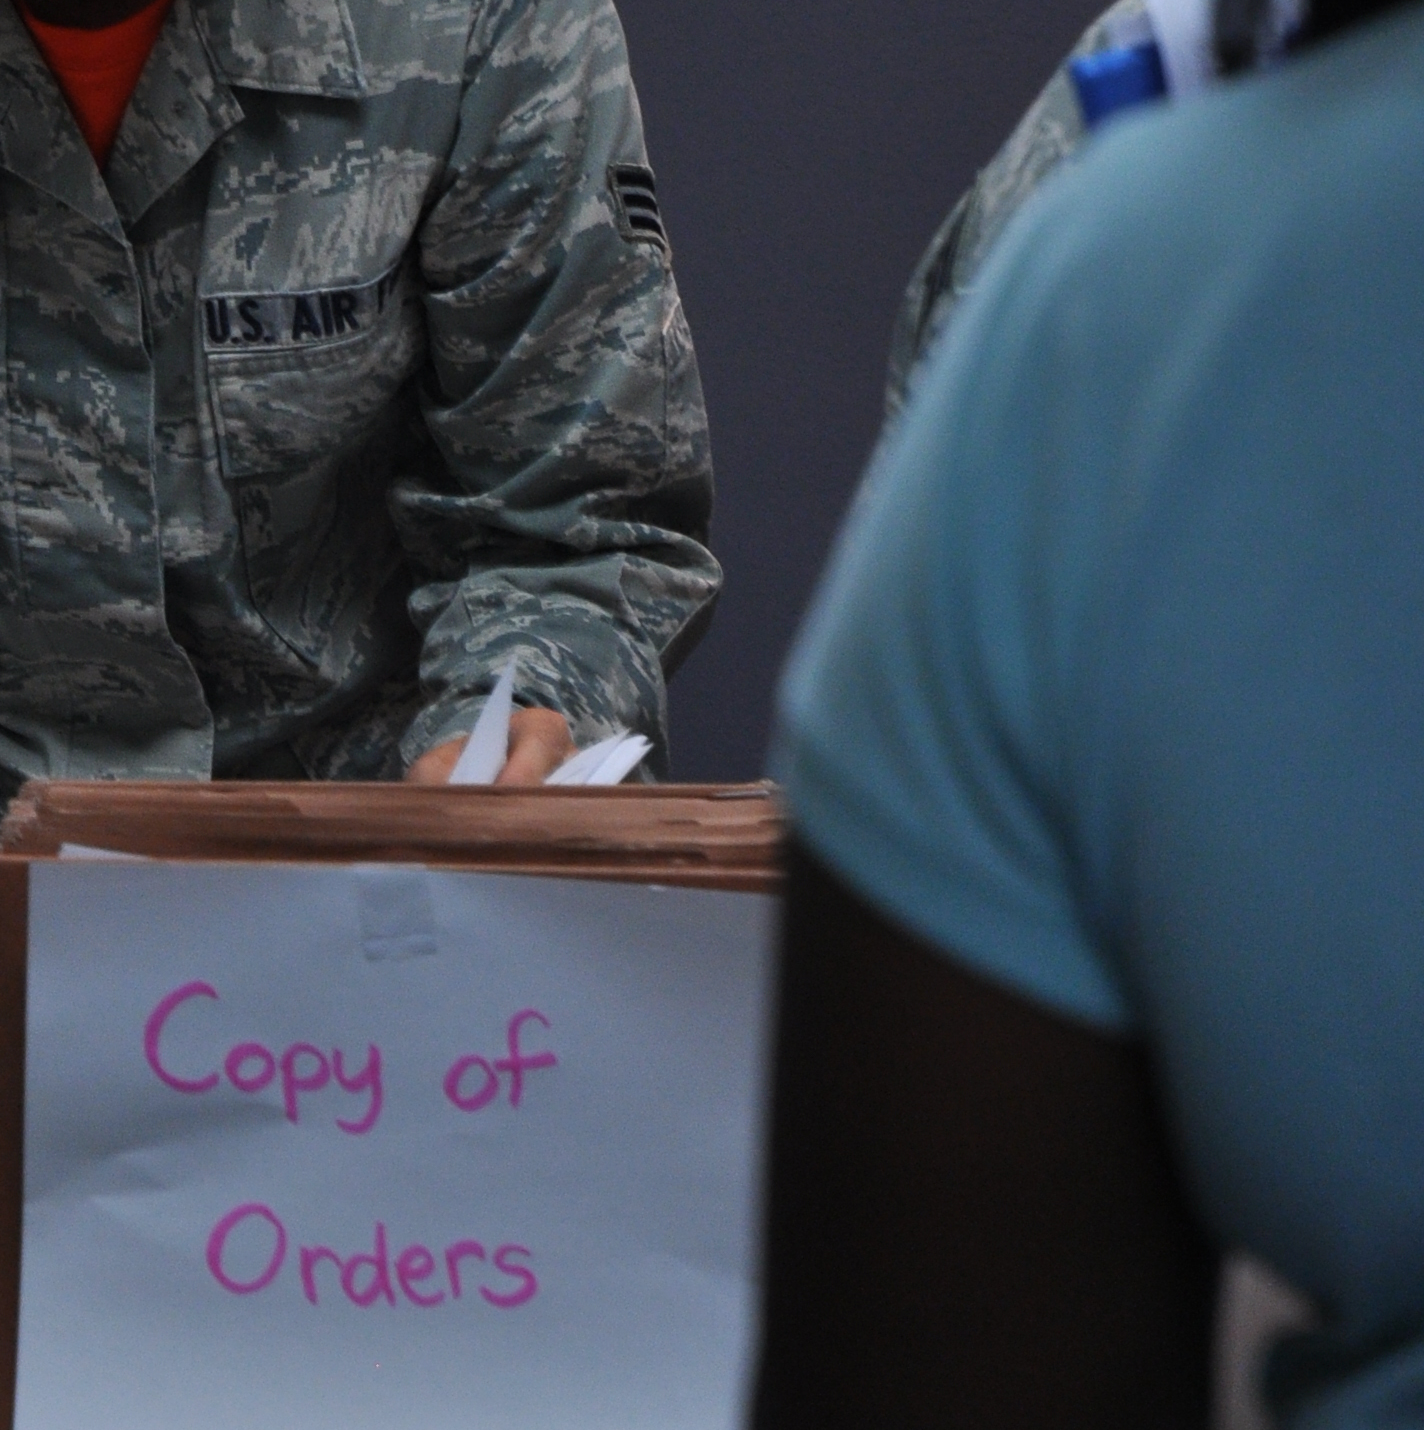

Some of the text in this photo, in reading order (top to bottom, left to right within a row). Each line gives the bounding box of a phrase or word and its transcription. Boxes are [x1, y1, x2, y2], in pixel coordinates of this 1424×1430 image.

[205, 289, 361, 344] U.S. AIR
[143, 980, 558, 1135] Copy of
[206, 1202, 539, 1309] Orders
